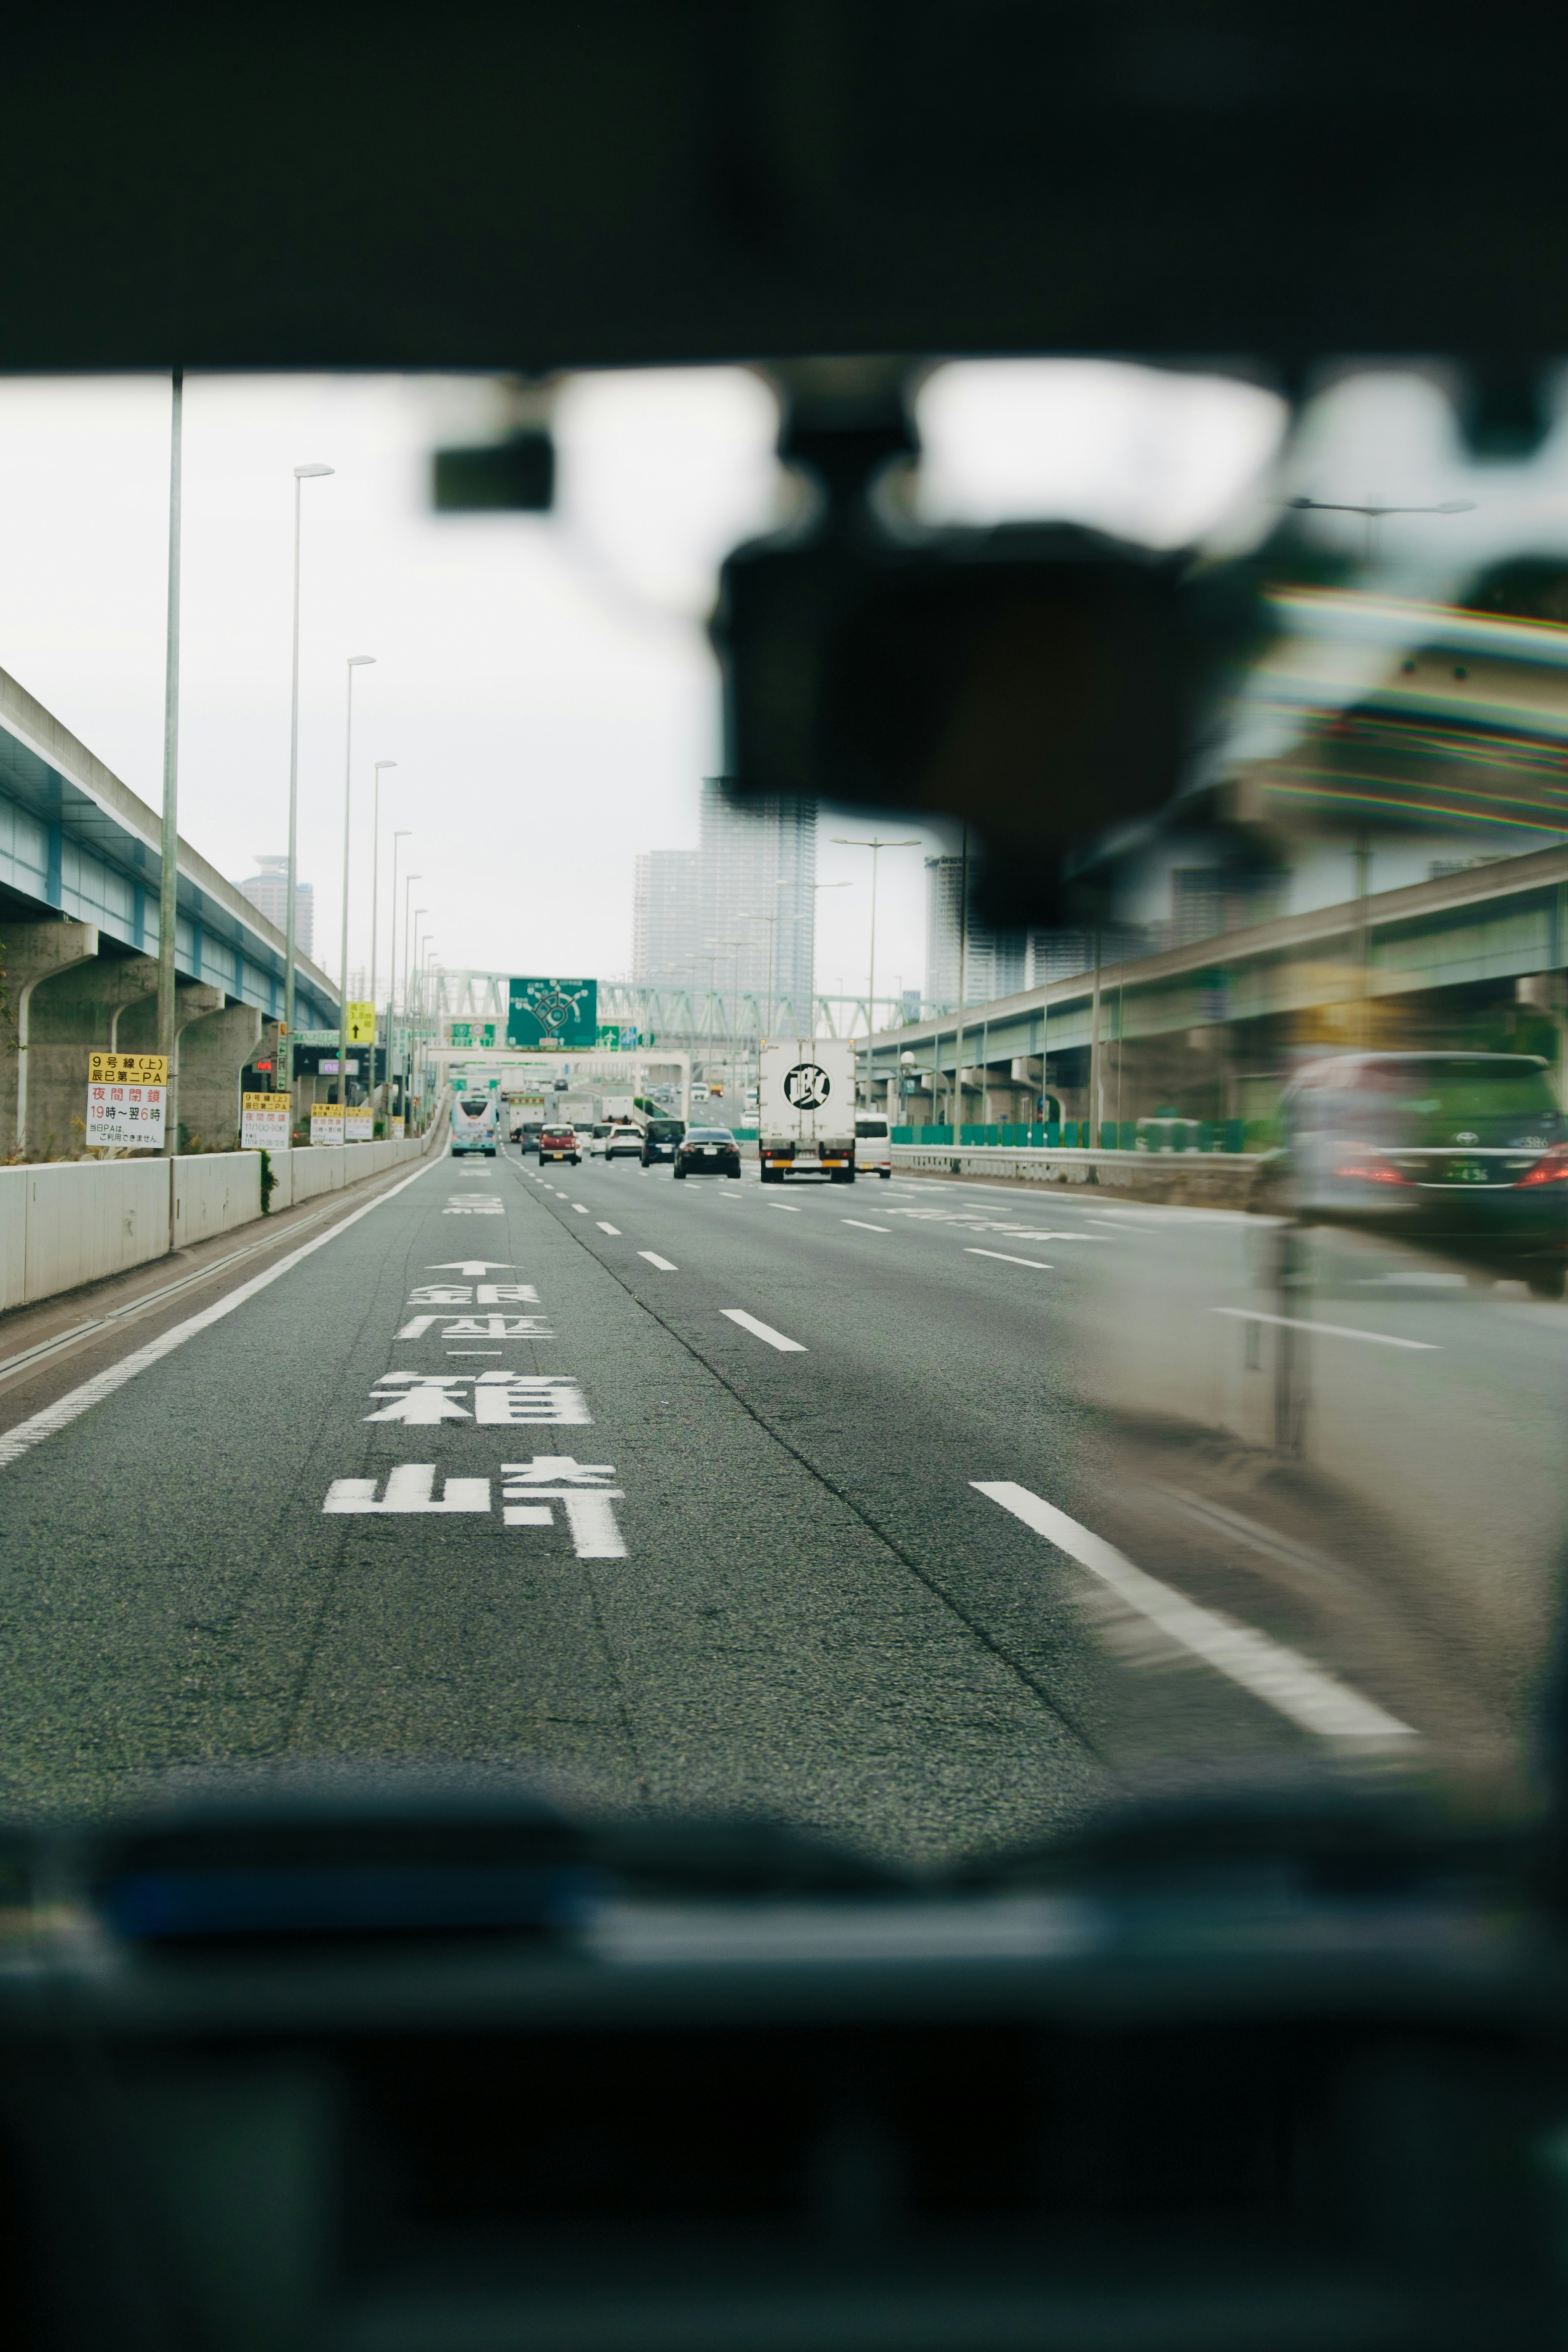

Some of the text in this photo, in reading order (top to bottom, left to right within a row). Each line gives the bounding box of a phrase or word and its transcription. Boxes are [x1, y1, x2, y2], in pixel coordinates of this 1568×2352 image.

[93, 1057, 162, 1070] 9号線(上)
[92, 1070, 161, 1083] 辰巳第二PA
[93, 1087, 160, 1102] 夜間閉鎖
